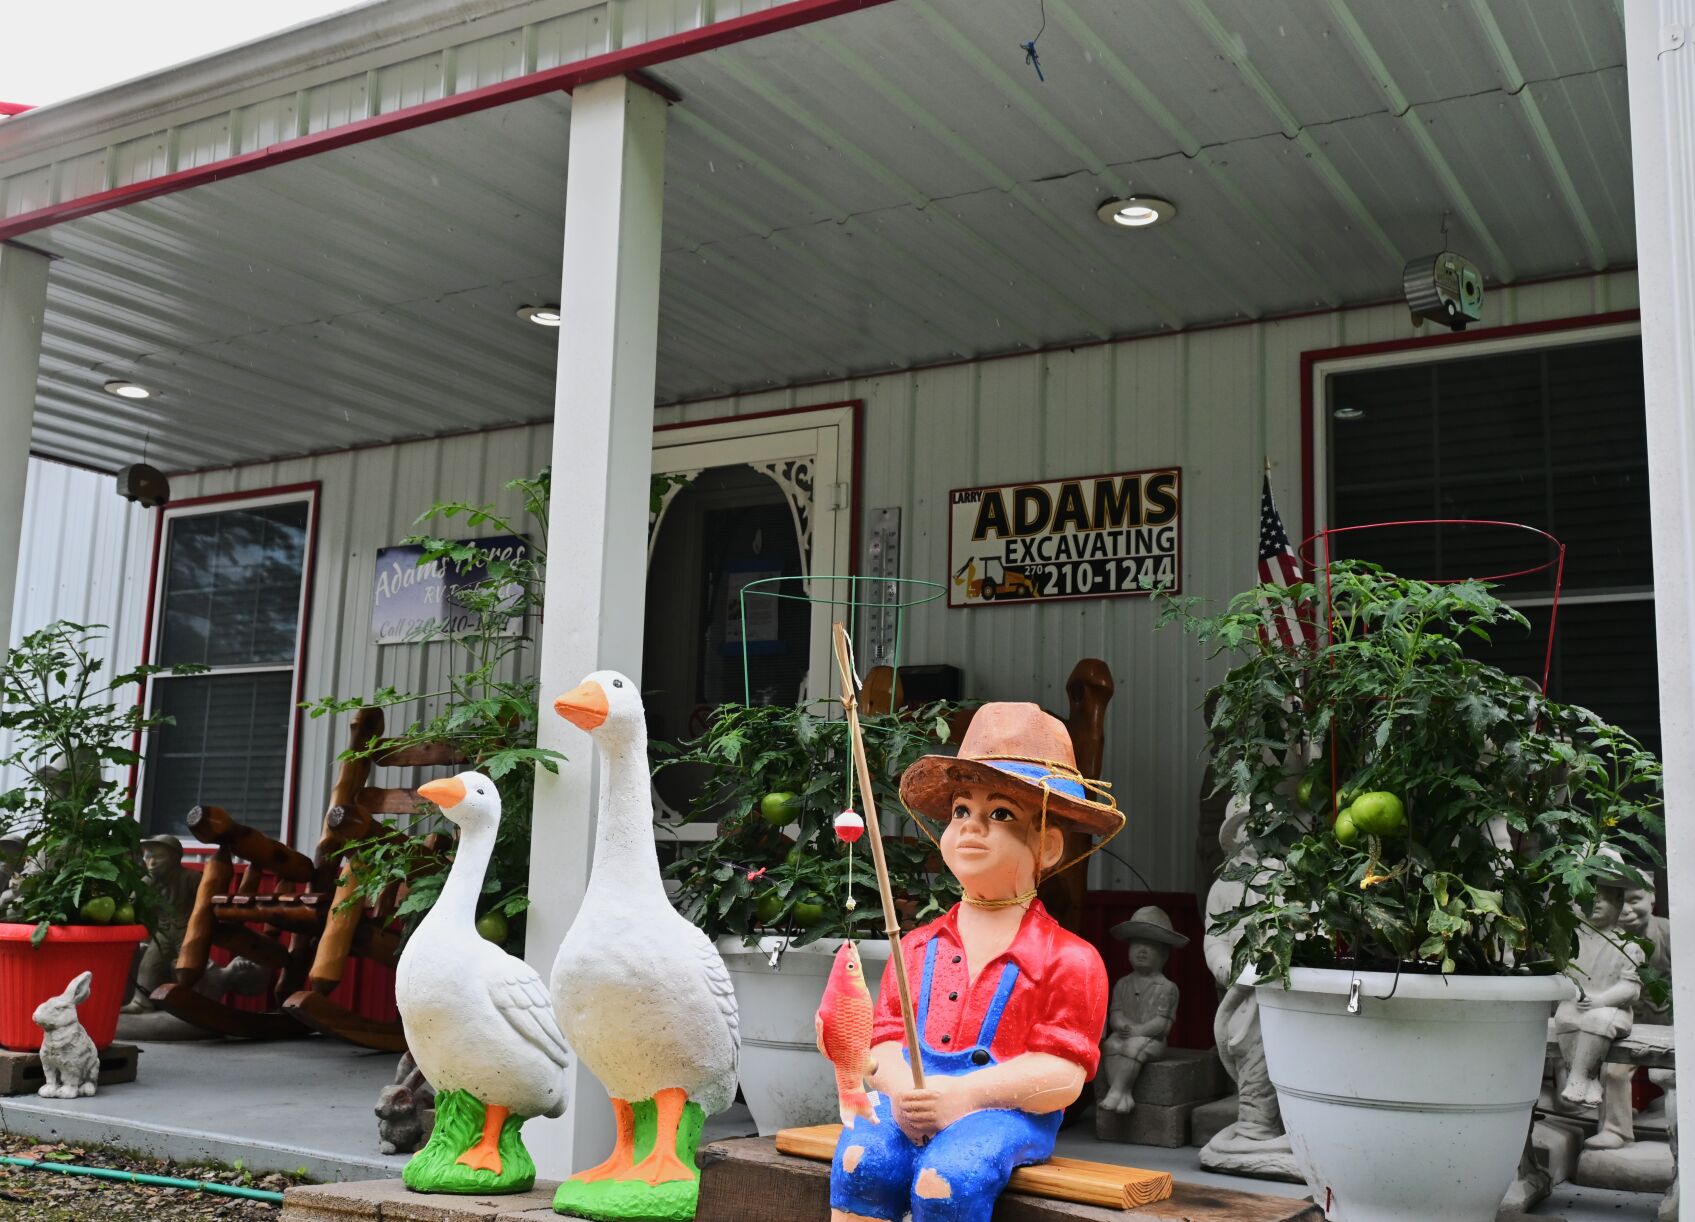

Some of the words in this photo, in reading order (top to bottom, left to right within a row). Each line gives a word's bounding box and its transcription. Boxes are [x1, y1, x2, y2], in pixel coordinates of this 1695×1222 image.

[952, 490, 982, 504] LARRY
[971, 472, 1179, 541] ADAMS
[1005, 526, 1175, 564] EXCAVATING
[375, 556, 452, 606] Adams
[423, 585, 446, 604] RV
[1024, 564, 1043, 576] 270
[1043, 556, 1174, 595] 210-1244
[380, 617, 405, 638] Call
